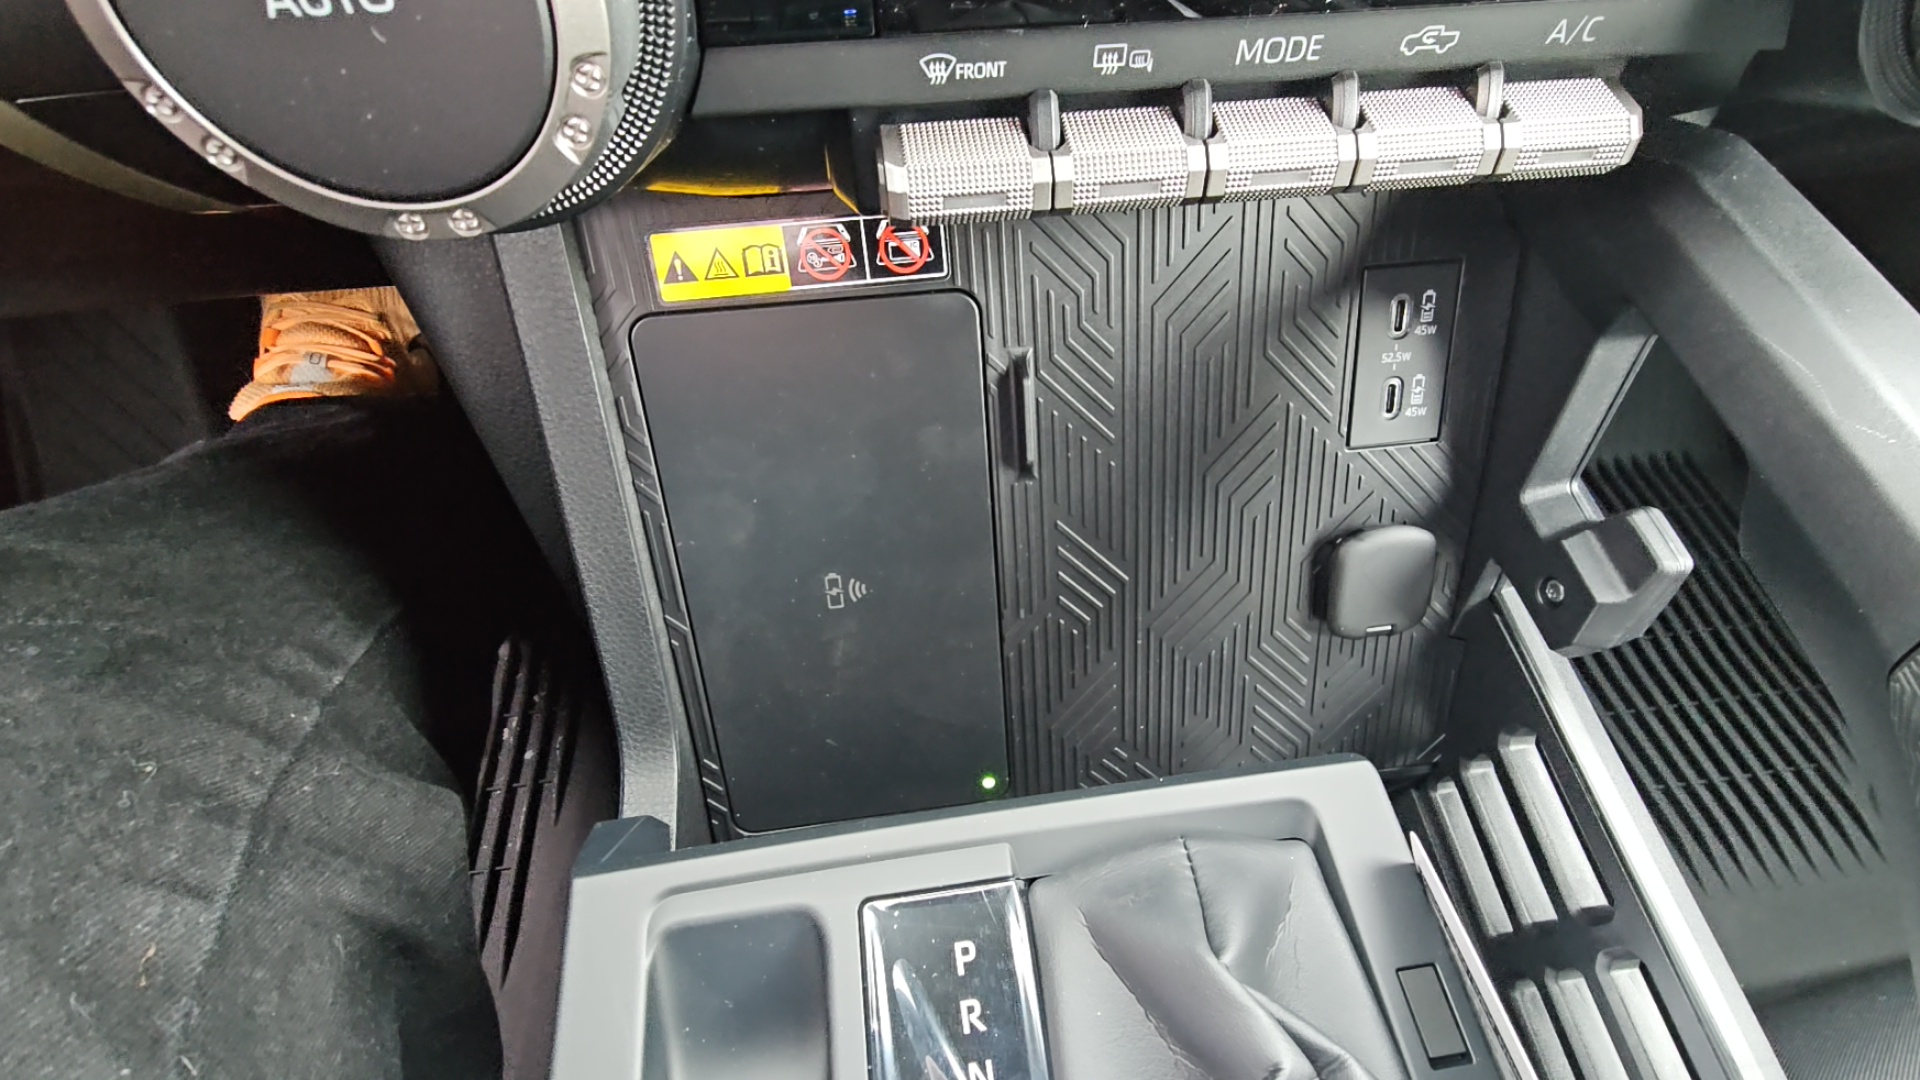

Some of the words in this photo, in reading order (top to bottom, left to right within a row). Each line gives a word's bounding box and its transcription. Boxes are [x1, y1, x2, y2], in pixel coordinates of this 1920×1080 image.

[1545, 15, 1605, 45] A/C
[1235, 34, 1325, 65] MODE
[955, 60, 1007, 80] FRONT
[1414, 324, 1437, 336] 45W
[1381, 352, 1412, 364] 52.5W
[1405, 406, 1427, 417] 45W
[954, 940, 976, 976] P
[960, 998, 988, 1035] R
